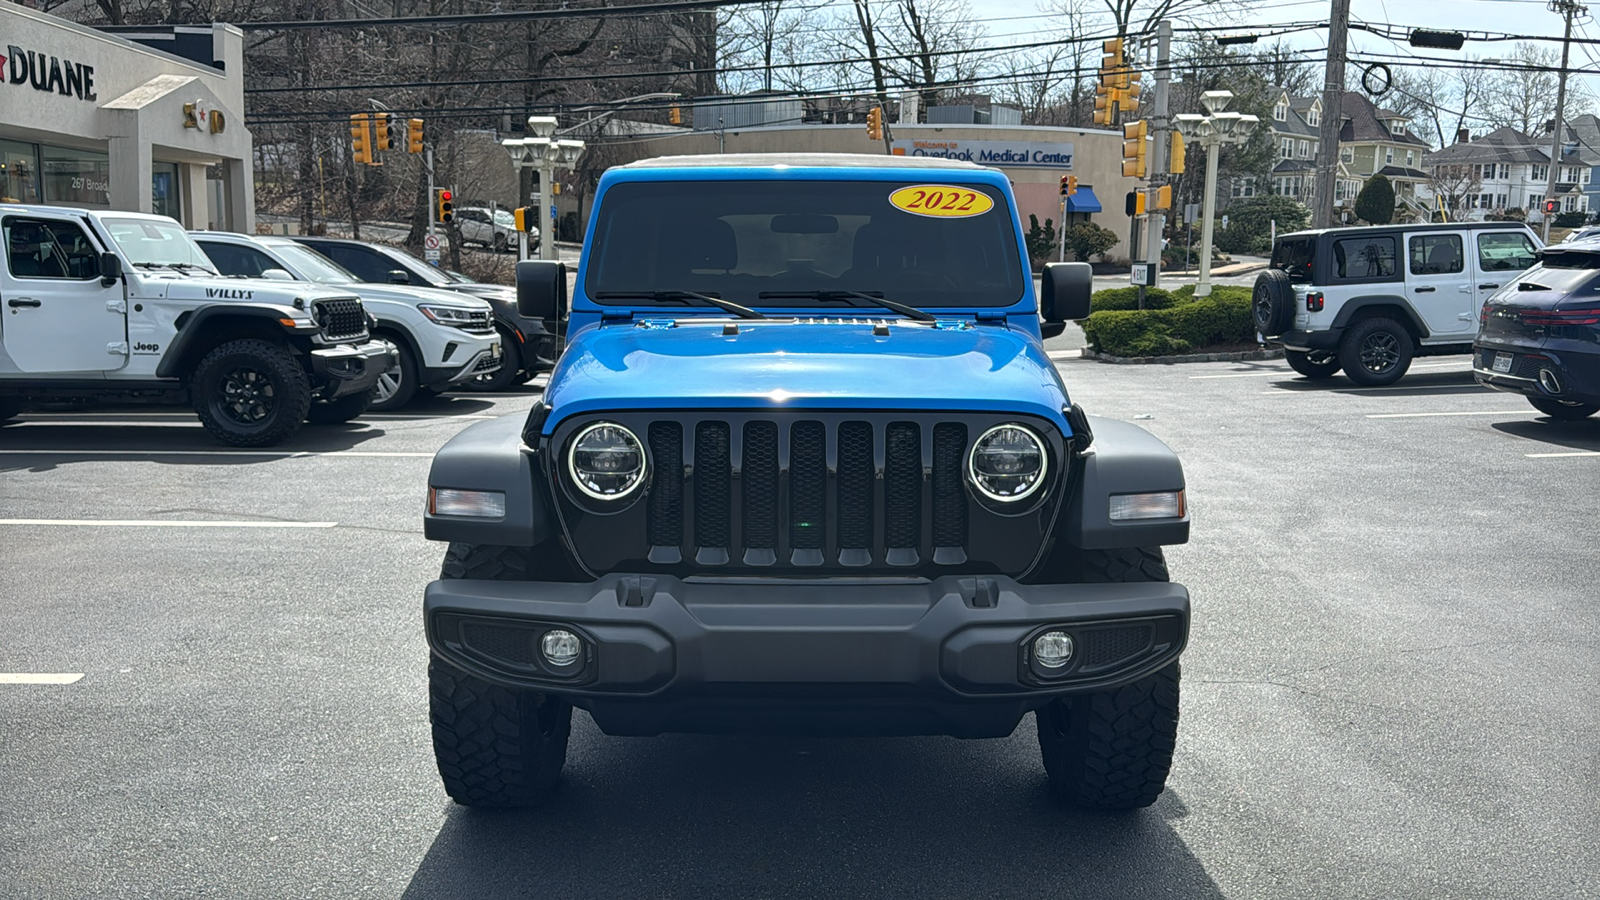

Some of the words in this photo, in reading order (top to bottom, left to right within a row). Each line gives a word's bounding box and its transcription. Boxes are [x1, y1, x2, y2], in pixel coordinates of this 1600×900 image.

[7, 44, 97, 102] DUANE
[913, 140, 948, 148] Welcome
[912, 147, 974, 161] Overlook
[979, 149, 1029, 162] Medical
[1032, 150, 1072, 163] Center
[71, 176, 85, 190] 267
[906, 190, 977, 211] 2022
[1136, 268, 1146, 281] EXIT
[205, 287, 254, 300] WILLYS
[133, 341, 160, 353] Jeep
